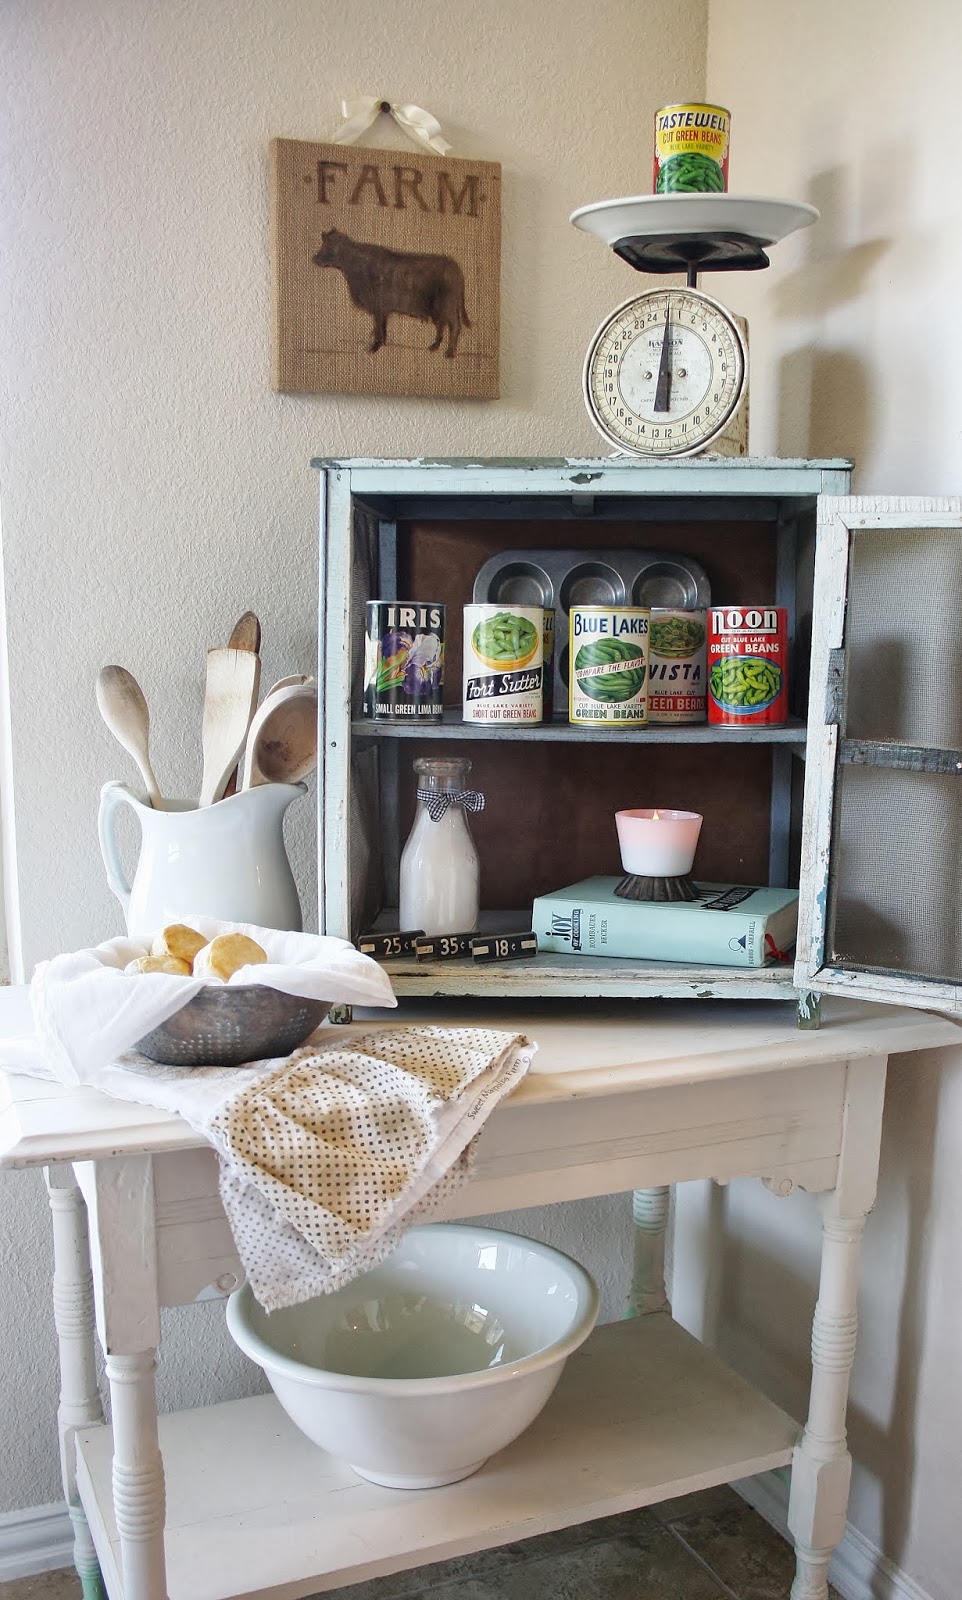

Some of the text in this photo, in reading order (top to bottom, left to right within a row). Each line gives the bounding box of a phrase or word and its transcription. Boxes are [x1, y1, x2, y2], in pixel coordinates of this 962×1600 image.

[658, 112, 726, 132] TASTEWELL
[663, 130, 722, 145] CUT GREEN BEANS
[681, 142, 694, 150] LAKE
[695, 142, 714, 151] VARIETY
[317, 160, 480, 218] FARM
[647, 313, 657, 322] 24
[634, 320, 645, 329] 23
[622, 331, 632, 340] 22
[614, 342, 622, 350] 21
[608, 354, 618, 363] 20
[605, 370, 613, 378] 19
[605, 383, 614, 392] 18
[609, 396, 617, 406] 17
[616, 408, 624, 417] 16
[625, 417, 632, 426] 15
[693, 416, 700, 425] 10
[638, 425, 646, 434] 14
[682, 424, 688, 432] 11
[652, 429, 660, 438] 13
[664, 429, 672, 438] 12
[387, 607, 441, 628] IRIS
[574, 613, 608, 636] BLUE
[612, 615, 648, 636] LAKES
[710, 644, 779, 653] GREEN BEANS
[649, 664, 700, 680] VISTA
[468, 674, 540, 698] Fort Sutter
[648, 698, 704, 710] REEN BEANS
[376, 704, 394, 714] SMALL
[395, 704, 416, 714] GREEN
[418, 704, 432, 714] LIMA
[576, 709, 644, 718] GREEN BEANS
[472, 710, 536, 718] SHORT CUT GREEN BEANS
[588, 914, 598, 948] ROMBAUER
